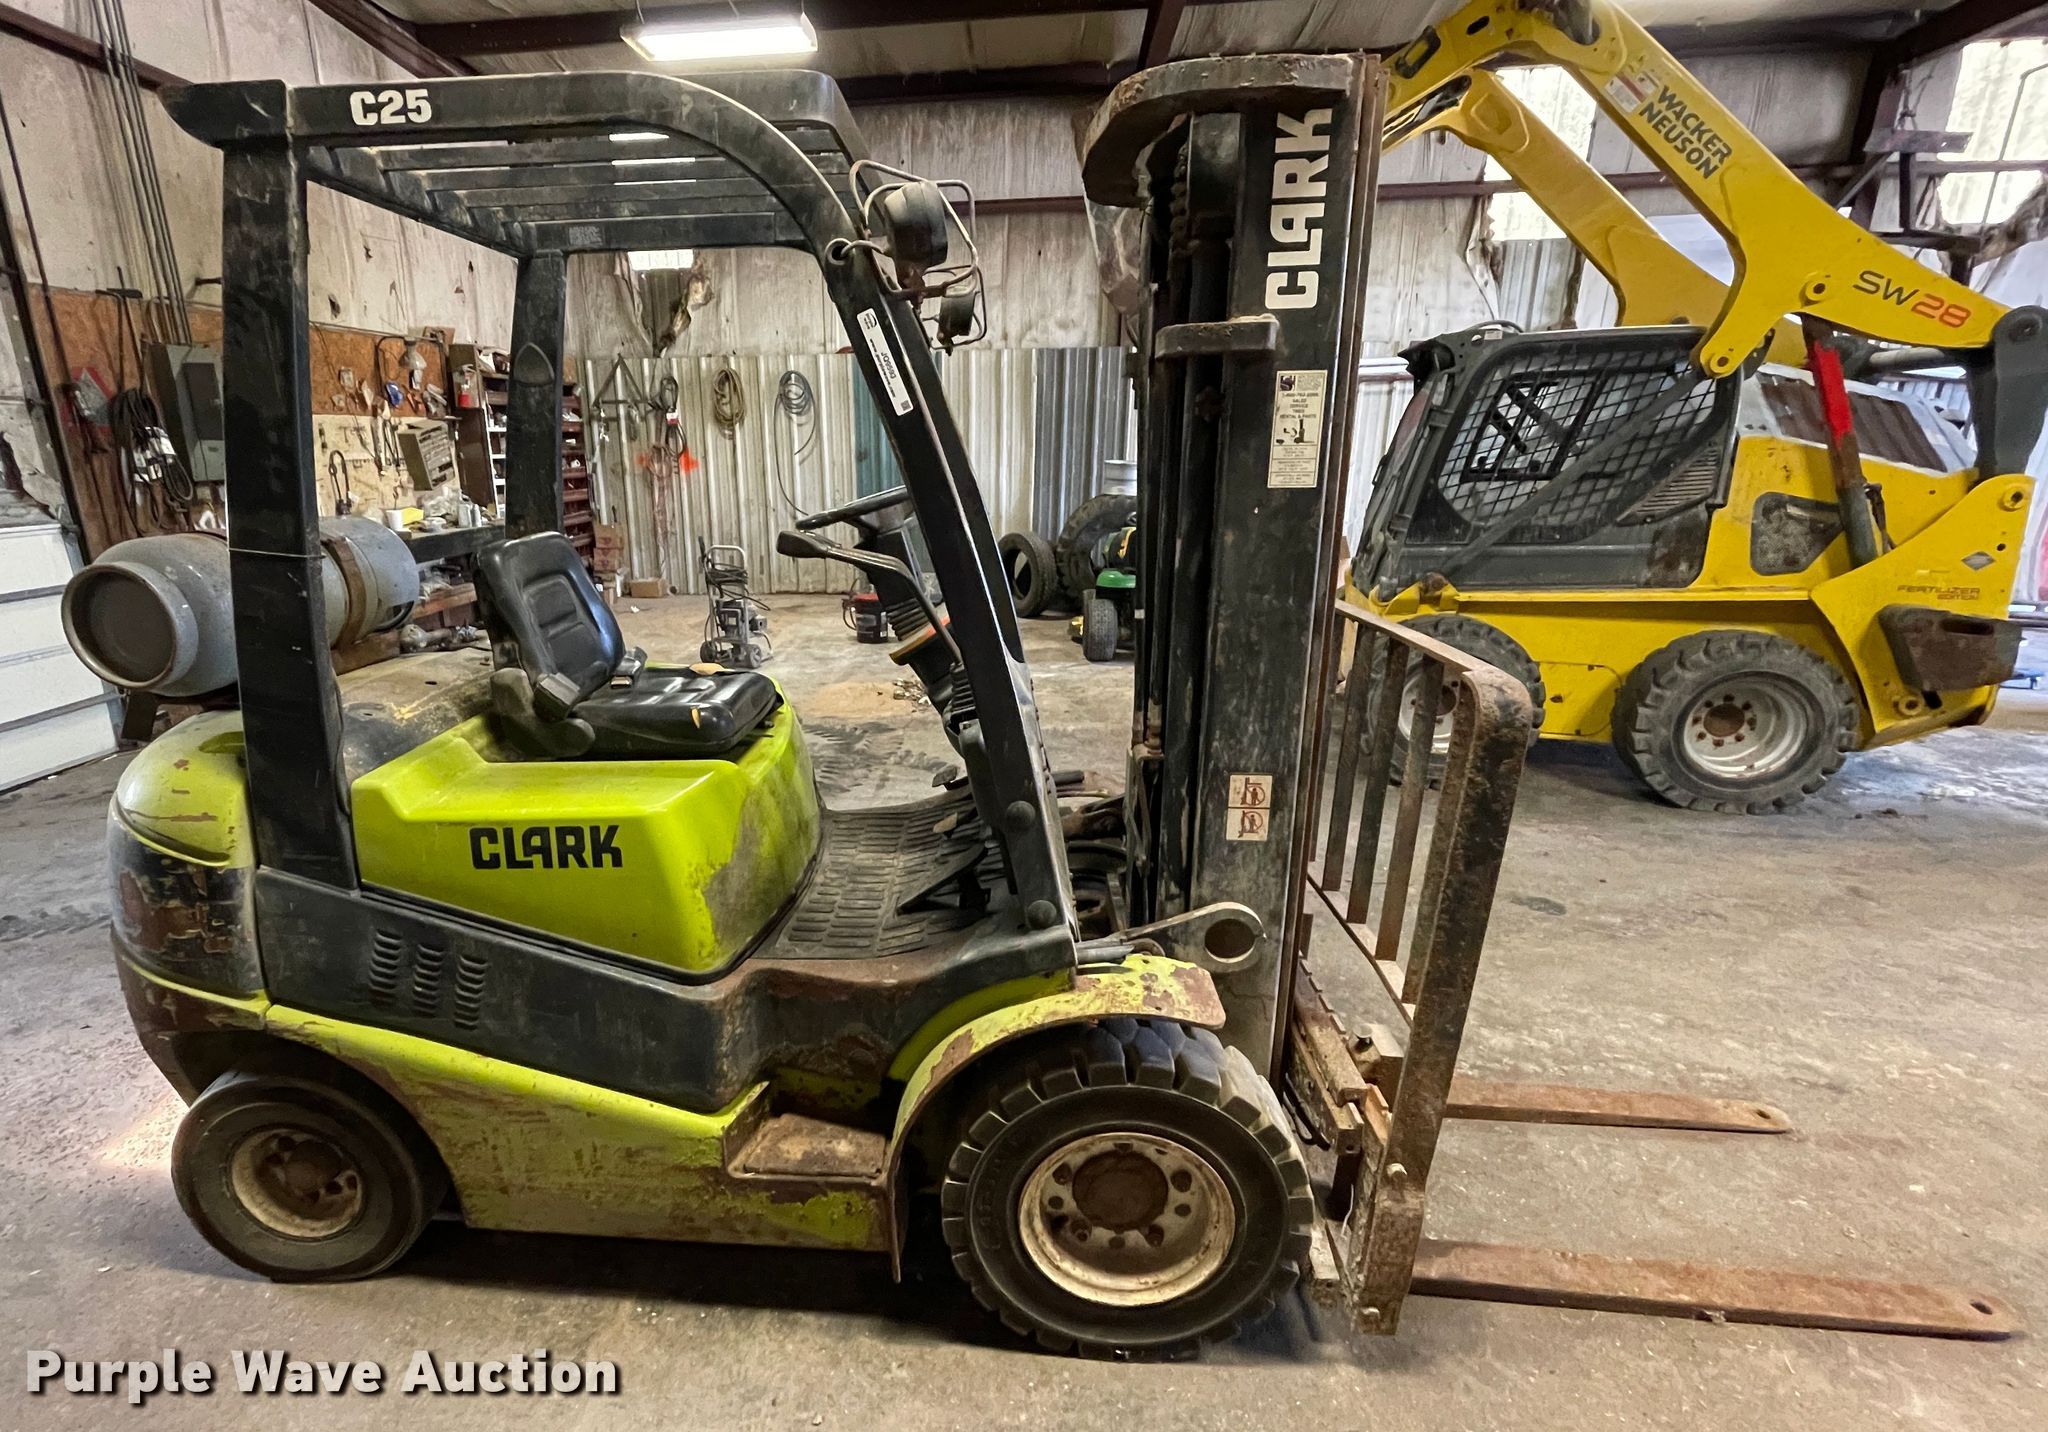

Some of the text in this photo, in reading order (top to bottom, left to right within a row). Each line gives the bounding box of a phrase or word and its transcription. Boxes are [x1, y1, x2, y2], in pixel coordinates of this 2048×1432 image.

[349, 88, 432, 126] C25
[1638, 101, 1719, 179] NEUSON
[1658, 85, 1733, 165] WACKER
[1265, 108, 1333, 310] CLARK
[469, 825, 623, 869] CLARK
